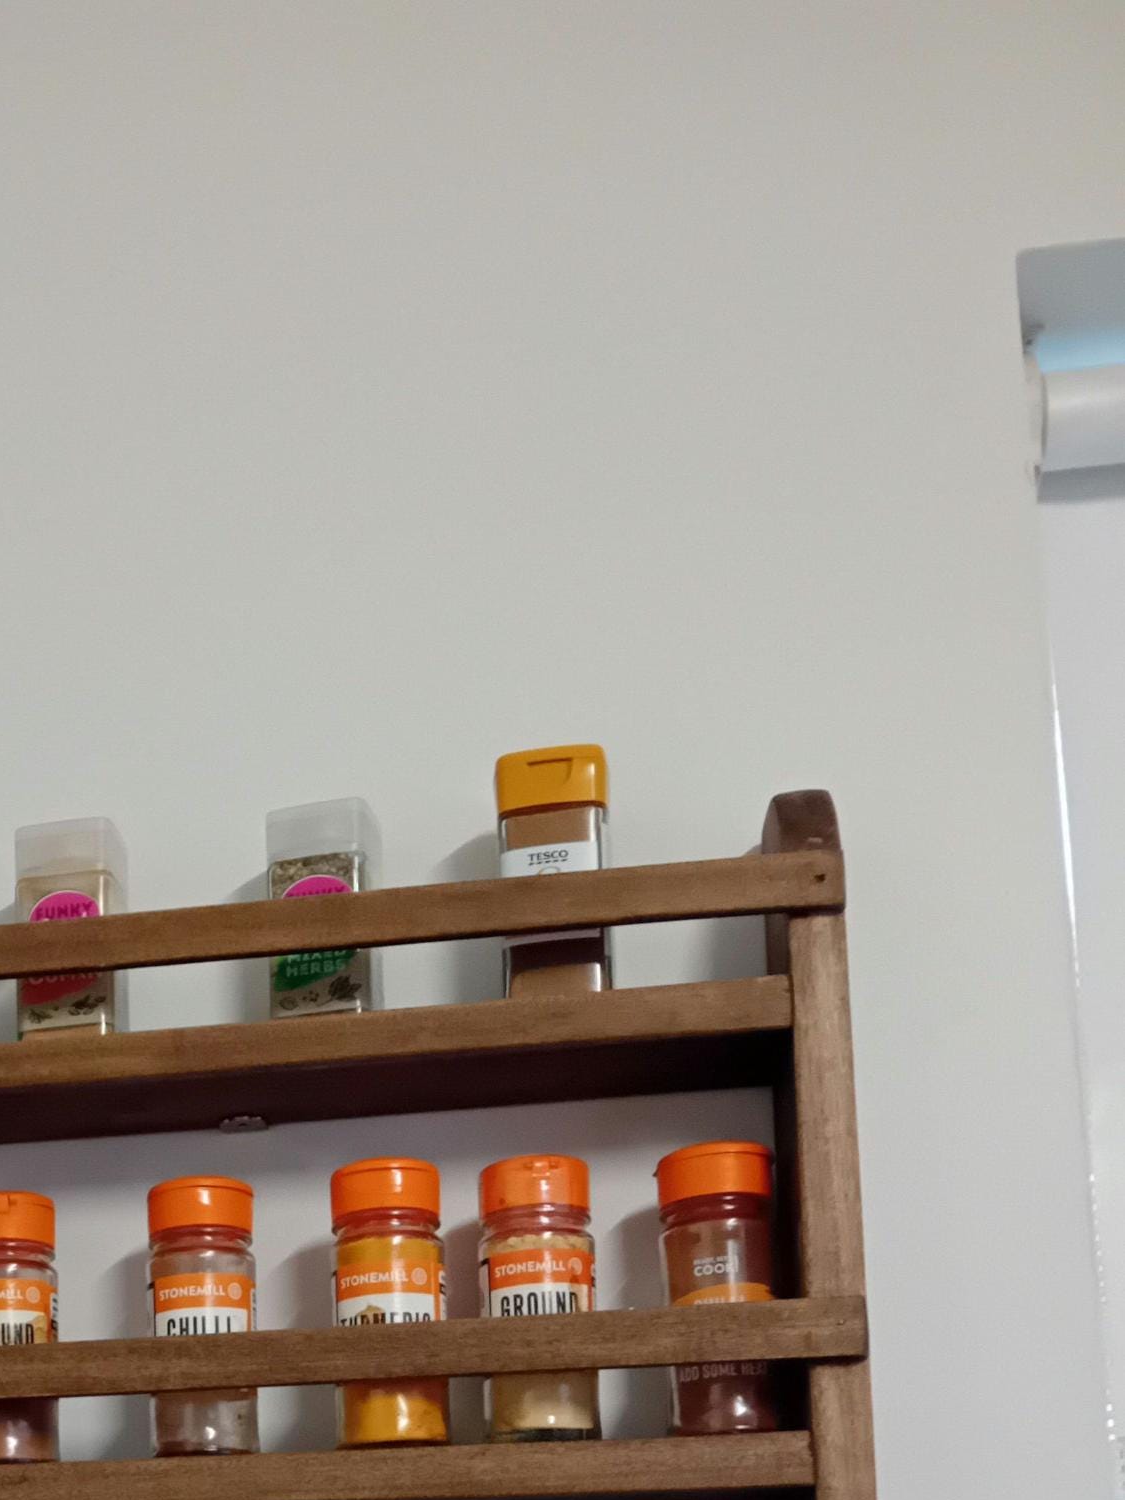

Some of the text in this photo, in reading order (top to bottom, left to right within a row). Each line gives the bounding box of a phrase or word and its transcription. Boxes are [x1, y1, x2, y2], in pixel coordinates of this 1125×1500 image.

[528, 849, 569, 862] TESCO
[36, 900, 91, 920] FUNKY
[495, 1259, 566, 1278] STONEMILL
[340, 1269, 409, 1289] STONEMILL
[159, 1283, 226, 1301] STONEMILL
[501, 1291, 578, 1317] GROUND
